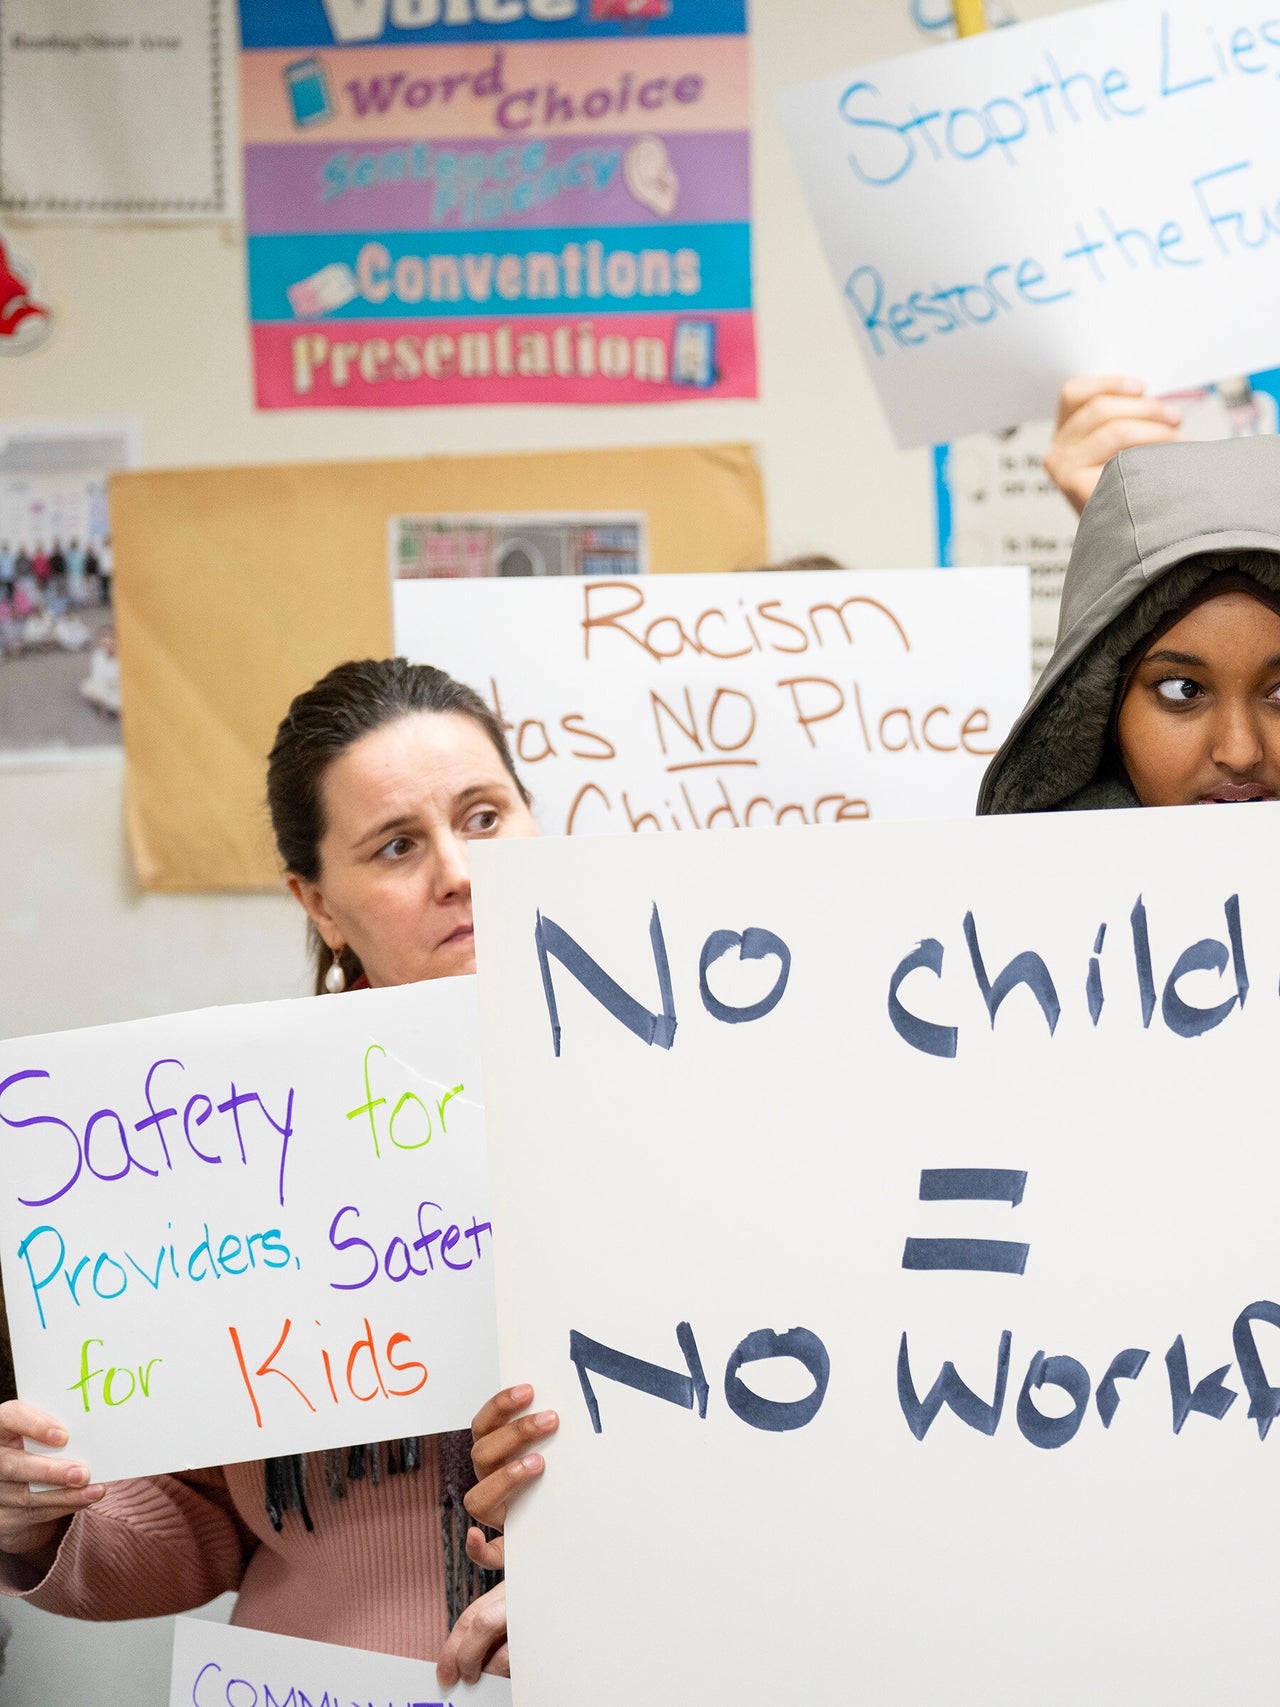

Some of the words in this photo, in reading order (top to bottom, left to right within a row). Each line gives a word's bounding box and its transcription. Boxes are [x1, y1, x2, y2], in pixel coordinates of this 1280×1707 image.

[344, 49, 505, 118] Word
[494, 70, 706, 132] Choice
[838, 82, 1029, 186] Stop
[1023, 50, 1146, 135] the
[356, 241, 702, 302] Conventions
[844, 264, 1073, 358] Restore
[1062, 207, 1202, 284] the
[293, 322, 668, 394] Presentation
[579, 580, 911, 664] Racism
[649, 685, 759, 757] NO
[776, 675, 1002, 757] Place
[0, 1058, 295, 1208] Safety
[345, 1043, 465, 1160] for
[328, 1200, 493, 1292] Safet
[68, 1337, 164, 1413] for
[228, 1316, 430, 1429] Kids
